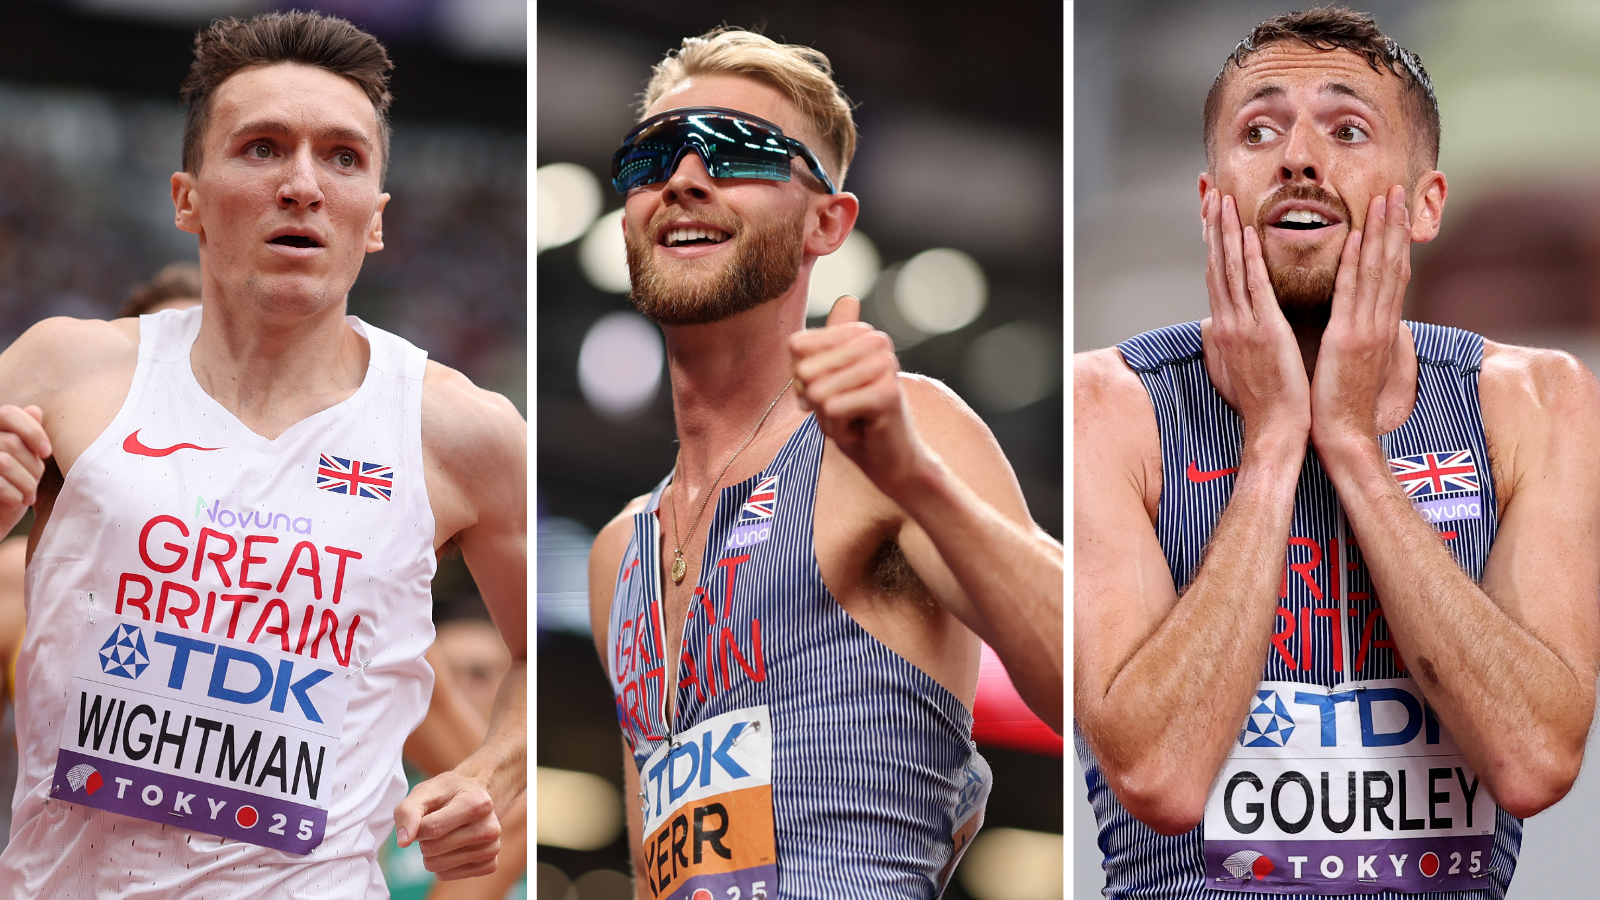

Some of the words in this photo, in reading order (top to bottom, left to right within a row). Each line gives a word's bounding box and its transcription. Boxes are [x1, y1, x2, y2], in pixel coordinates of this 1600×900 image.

[195, 496, 313, 536] Novuna
[726, 527, 770, 548] vuna
[1421, 501, 1482, 522] ovuna
[137, 514, 363, 606] GREAT
[114, 572, 362, 668] BRITAIN
[1270, 606, 1406, 673] RITA
[153, 631, 335, 725] TDK
[76, 691, 327, 802] WIGHTMAN
[648, 721, 751, 818] TDK
[1222, 766, 1480, 836] GOURLEY
[644, 802, 733, 900] KERR
